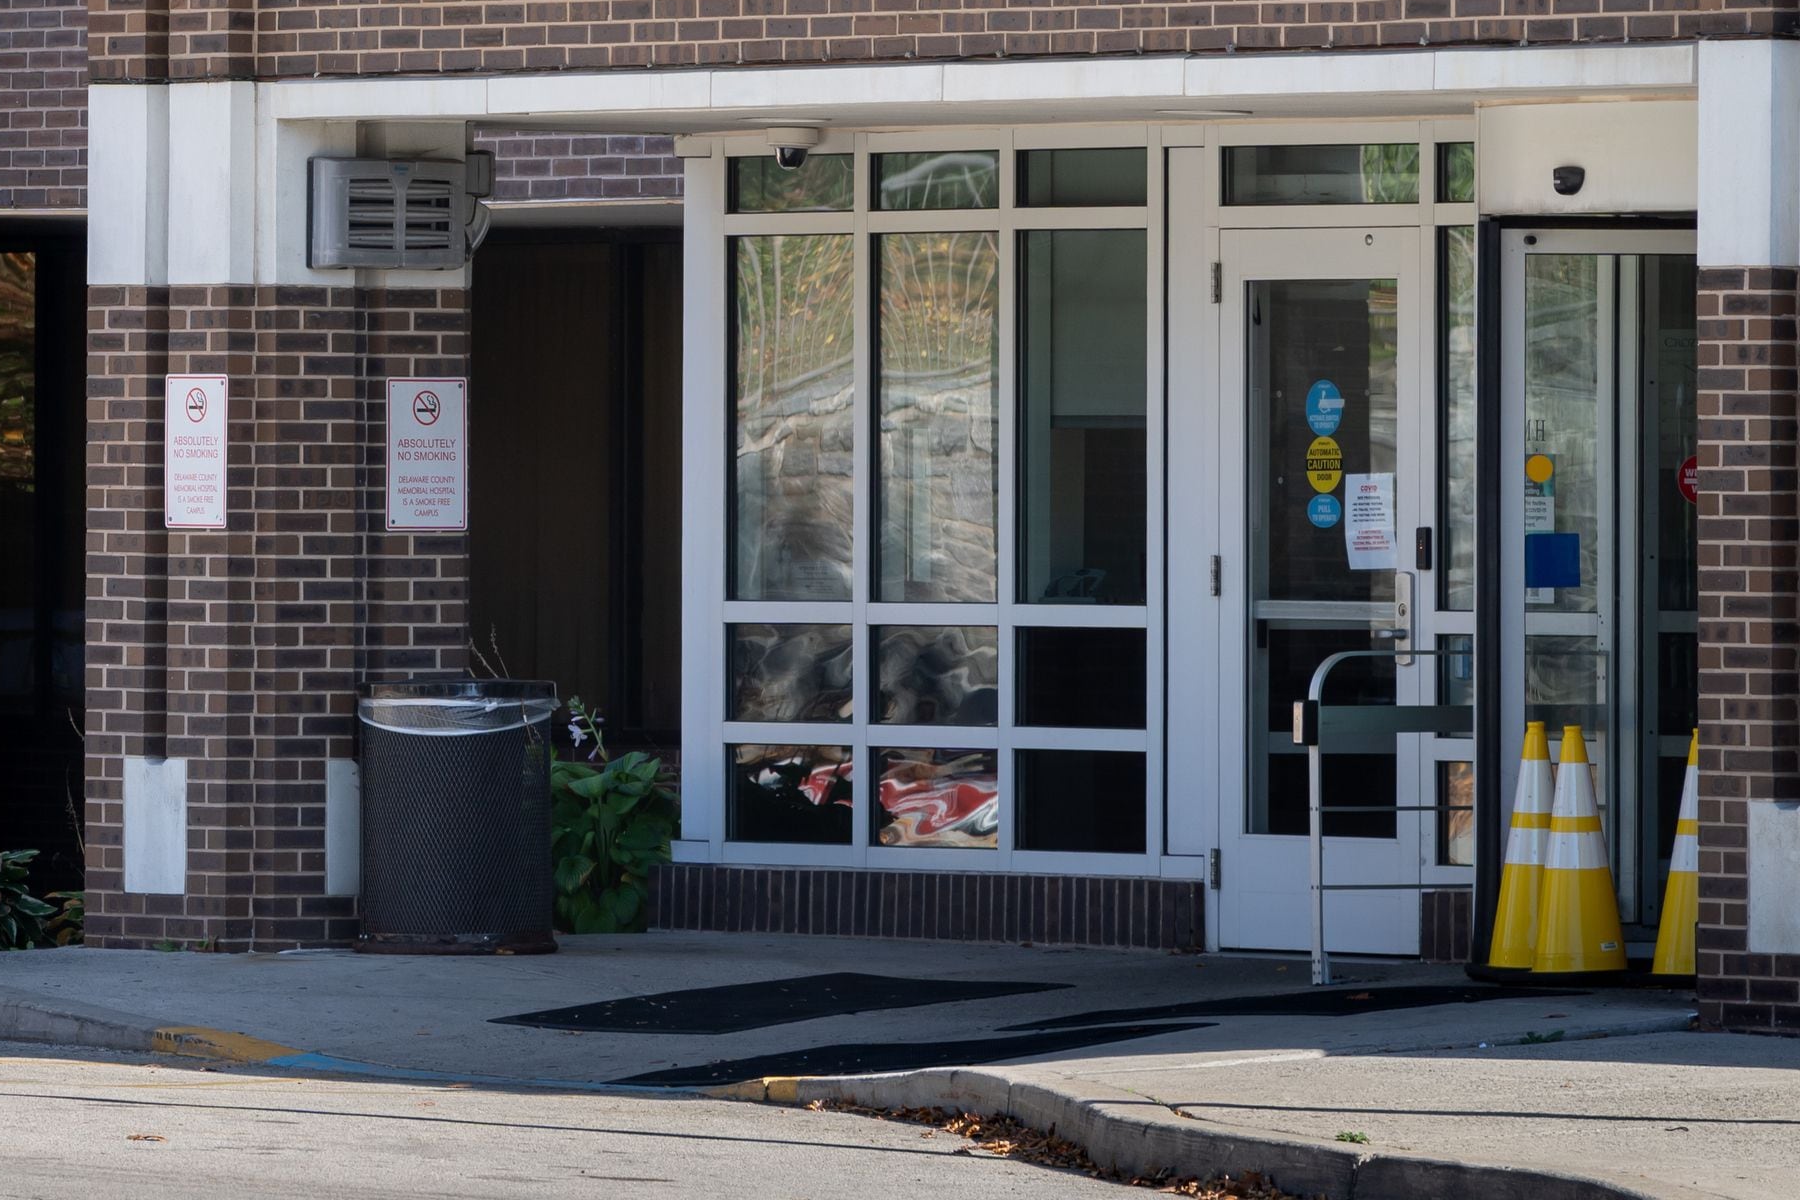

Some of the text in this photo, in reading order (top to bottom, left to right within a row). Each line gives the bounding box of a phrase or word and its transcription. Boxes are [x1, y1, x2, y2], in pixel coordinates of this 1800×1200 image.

[173, 436, 219, 446] ABSOLUTELY
[397, 438, 456, 448] ABSOLUTELY
[173, 449, 219, 459] NO SMOKING
[397, 451, 457, 461] NO SMOKING
[1308, 448, 1340, 457] AUTOMATIC
[1307, 460, 1341, 470] CAUTION
[198, 473, 217, 481] COUNTY
[398, 475, 455, 484] DELAWARE COUNTY
[1316, 473, 1333, 481] DOOR
[197, 484, 218, 492] HOSPITAL
[397, 486, 456, 495] MEMORIAL HOSPITAL
[402, 498, 408, 506] IS
[415, 498, 437, 506] SMOKE
[437, 498, 451, 506] FREE
[414, 509, 439, 517] CAMPUS
[1317, 504, 1332, 513] PULL
